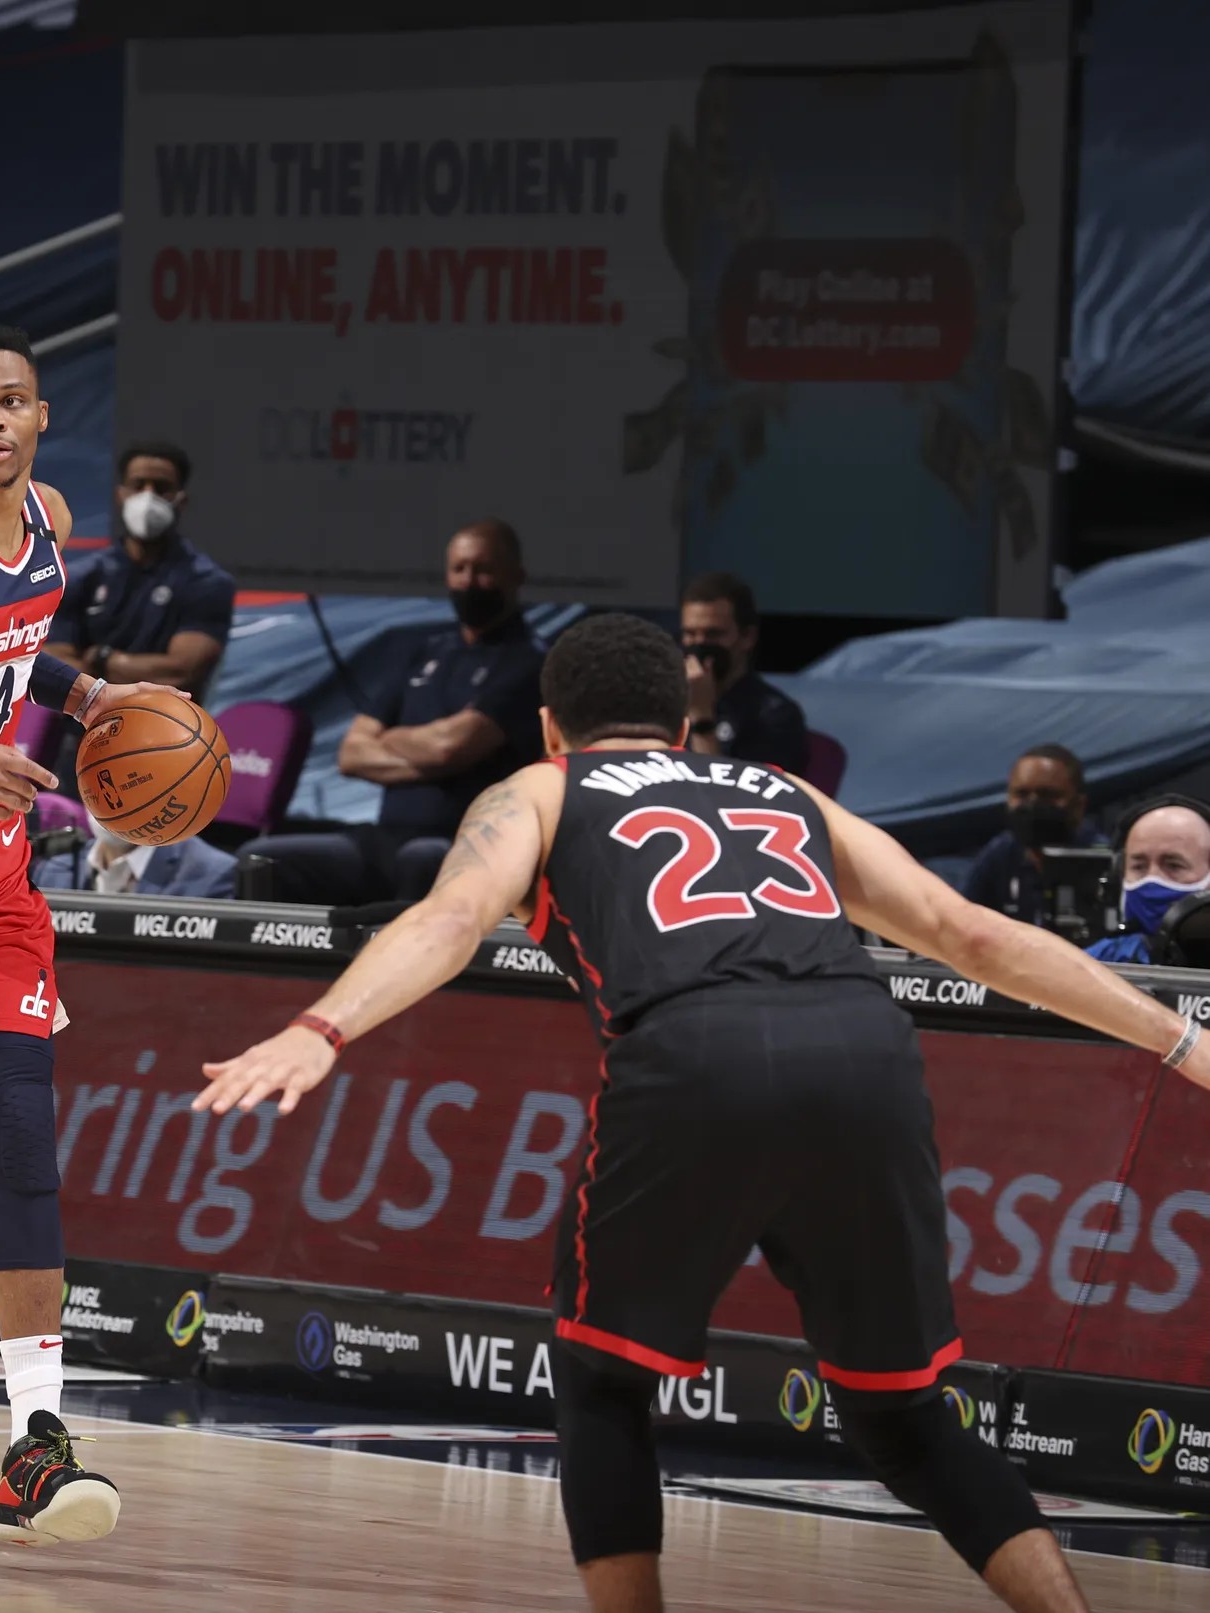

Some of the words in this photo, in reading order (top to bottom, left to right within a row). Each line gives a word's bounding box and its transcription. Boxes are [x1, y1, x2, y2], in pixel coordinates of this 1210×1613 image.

[154, 141, 259, 217] WIN
[269, 140, 364, 216] THE
[375, 137, 627, 217] MOMENT.
[151, 247, 353, 337] ONLINE,
[365, 248, 624, 324] ANYTIME.
[30, 565, 56, 583] GEICO
[125, 795, 188, 839] SPALD
[608, 806, 841, 932] 23
[134, 913, 217, 941] WGL.COM
[251, 921, 334, 950] #ASKWGL
[492, 945, 565, 976] #ASKW
[889, 976, 987, 1006] WGL.COM
[301, 1074, 478, 1232] US
[69, 1285, 101, 1308] WGL
[204, 1311, 264, 1334] ampshire
[334, 1322, 419, 1353] Washington
[333, 1344, 362, 1368] Gas
[446, 1331, 515, 1394] WE
[1175, 1448, 1210, 1473] Gas
